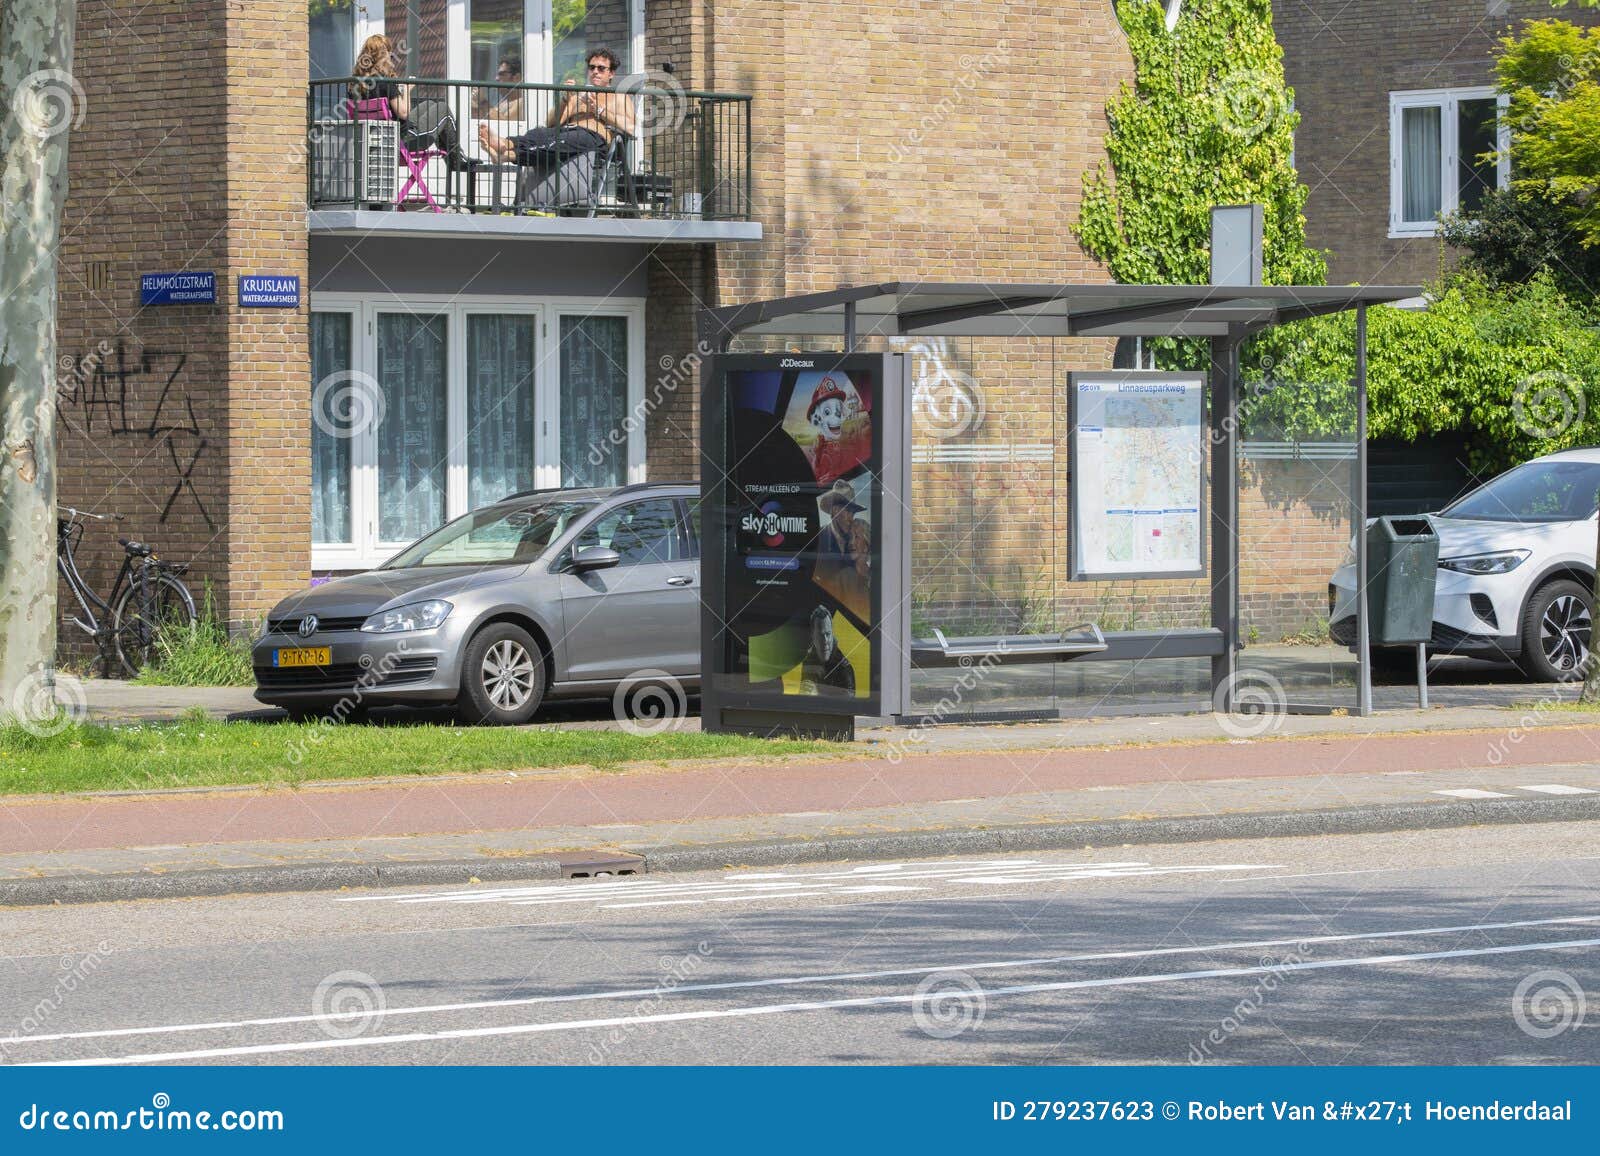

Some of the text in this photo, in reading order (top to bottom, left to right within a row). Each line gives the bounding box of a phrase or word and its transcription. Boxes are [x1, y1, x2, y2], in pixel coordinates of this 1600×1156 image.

[142, 275, 213, 290] HELMHOLTZSTRAAT
[243, 279, 296, 292] KRUISLAAN
[169, 291, 213, 300] WATERGRAAFSMEER
[241, 294, 298, 304] WATERGRAAFSMEER
[779, 358, 815, 368] JCDecaux
[1118, 383, 1186, 394] Linnaeusparkweg
[744, 484, 768, 493] STREAM
[282, 649, 325, 665] 9-TKP-16
